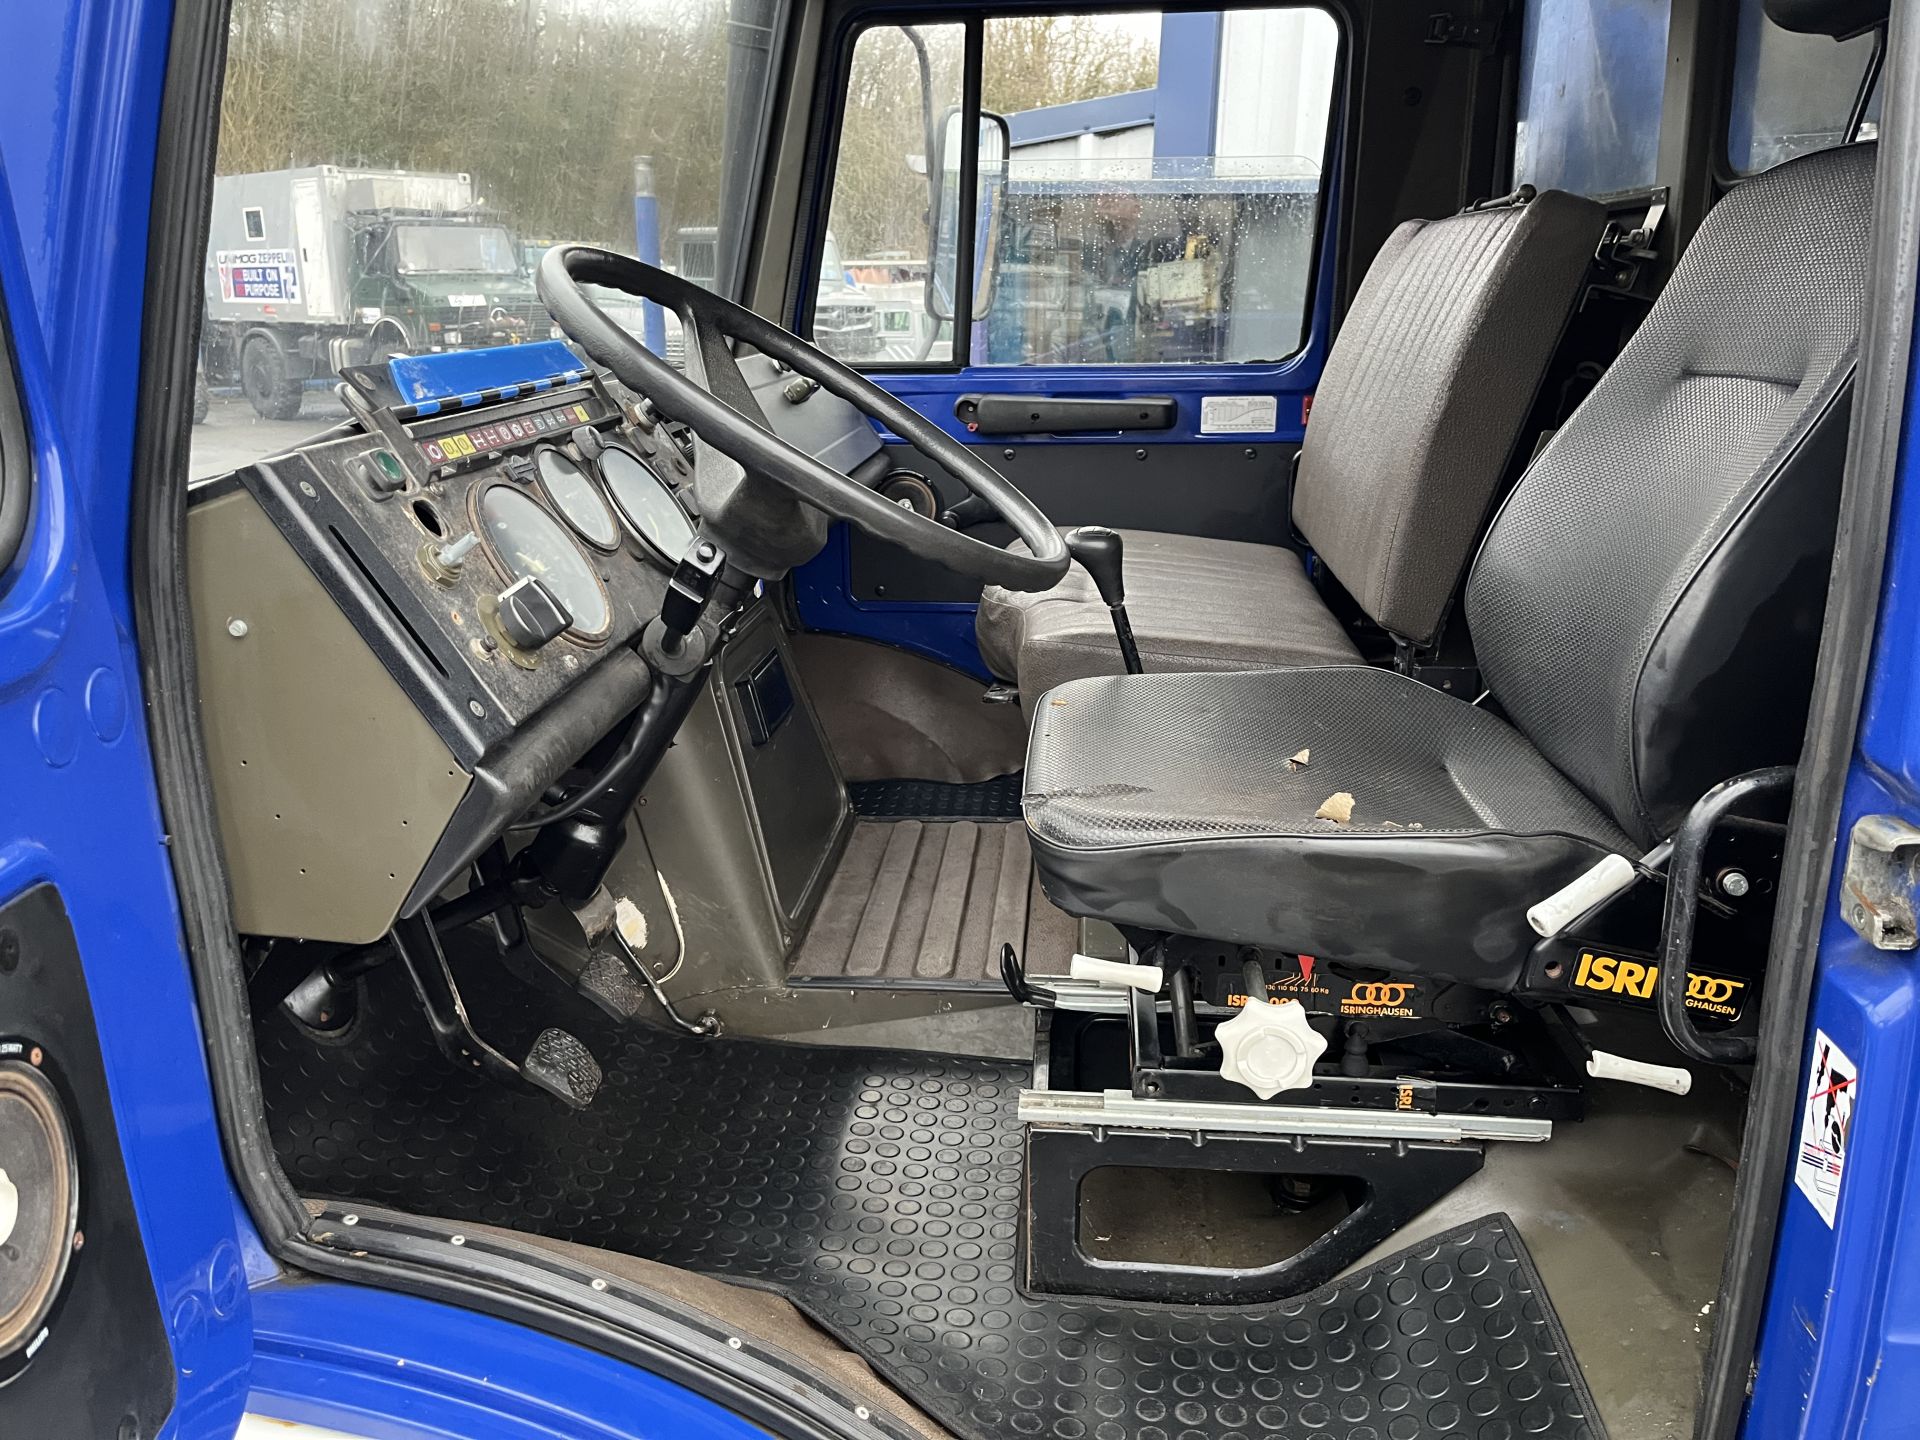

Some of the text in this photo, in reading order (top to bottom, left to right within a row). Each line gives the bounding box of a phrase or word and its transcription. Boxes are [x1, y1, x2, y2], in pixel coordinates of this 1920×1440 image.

[245, 284, 280, 297] PURPOSE
[1575, 953, 1658, 999] ISRI
[1227, 994, 1248, 1006] ISR
[1685, 998, 1736, 1015] GHAUSEN
[1340, 1005, 1413, 1016] ISRINGHAUSEN
[1399, 1085, 1413, 1109] ISRI
